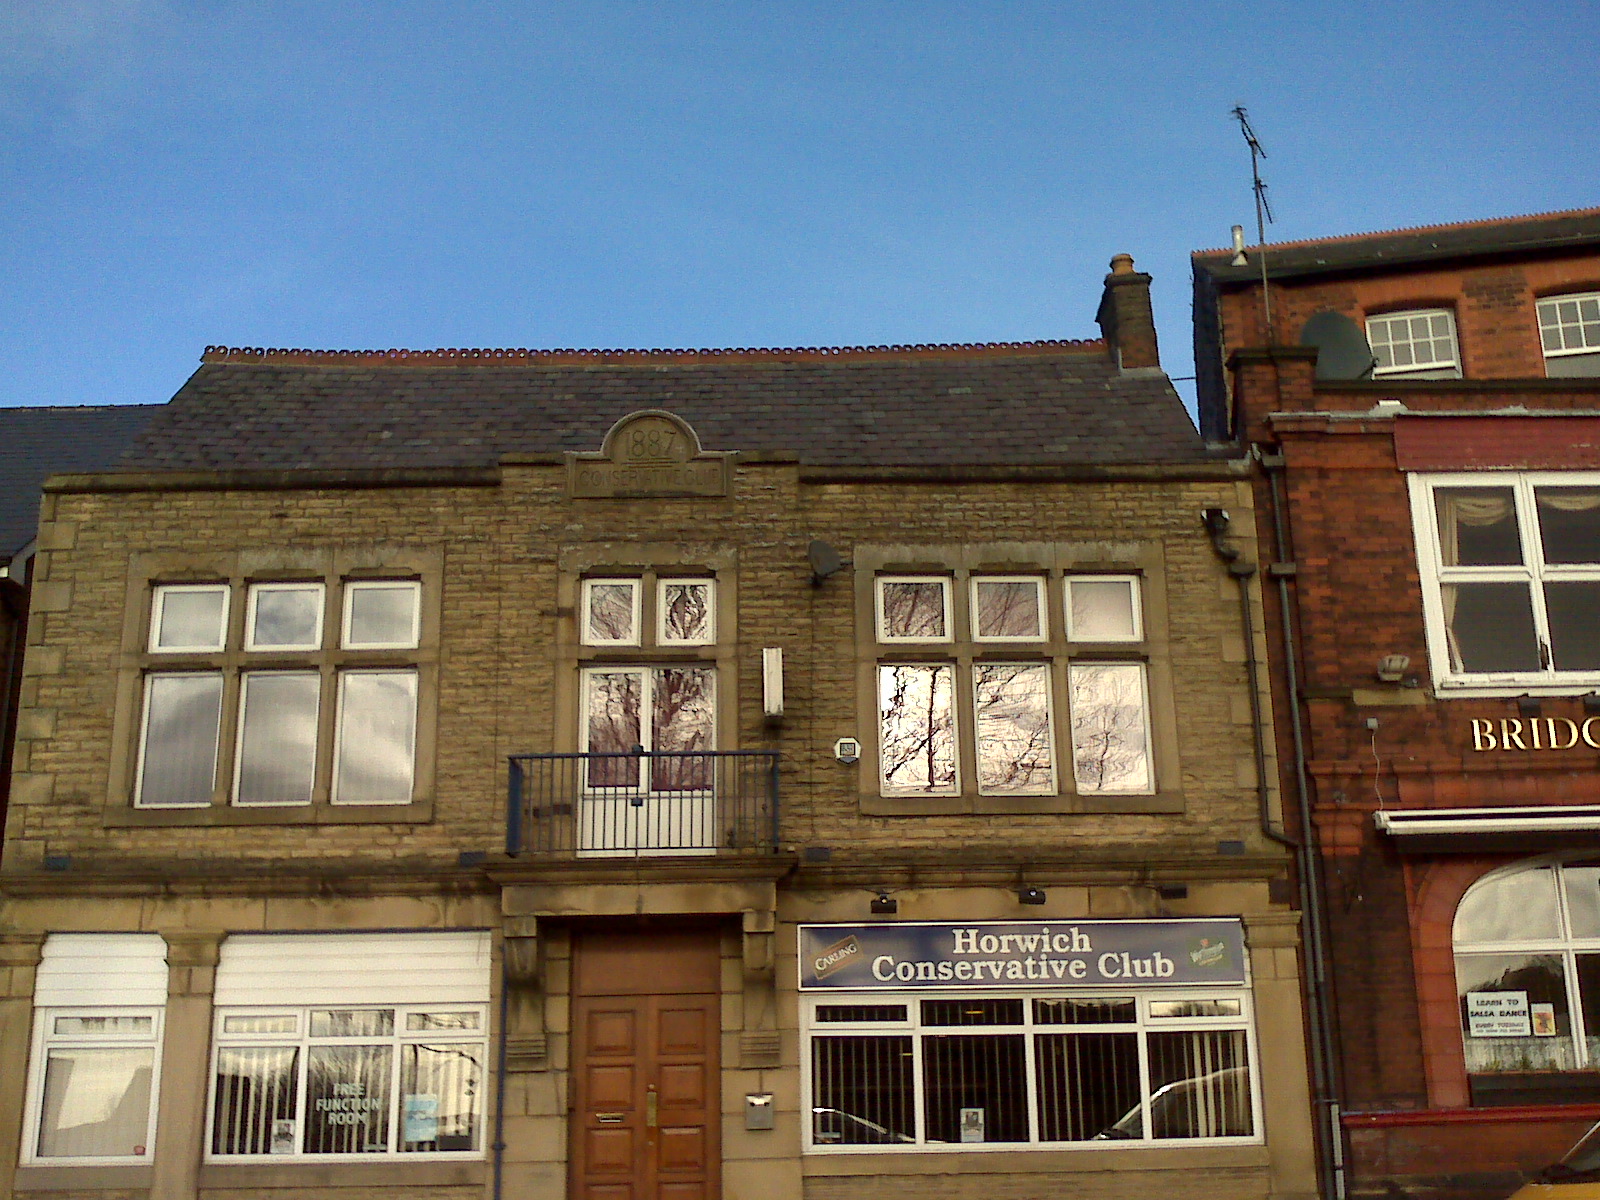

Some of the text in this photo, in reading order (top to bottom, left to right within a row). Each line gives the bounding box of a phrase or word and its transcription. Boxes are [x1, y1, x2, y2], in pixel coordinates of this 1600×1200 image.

[624, 430, 677, 457] 1887
[951, 927, 1093, 954] Horwich
[815, 943, 857, 971] CARLING
[871, 953, 1087, 982] Conservative
[1097, 951, 1175, 979] Club
[333, 1083, 366, 1096] FREE
[315, 1098, 383, 1112] FUNCTION
[328, 1112, 370, 1126] ROOM
